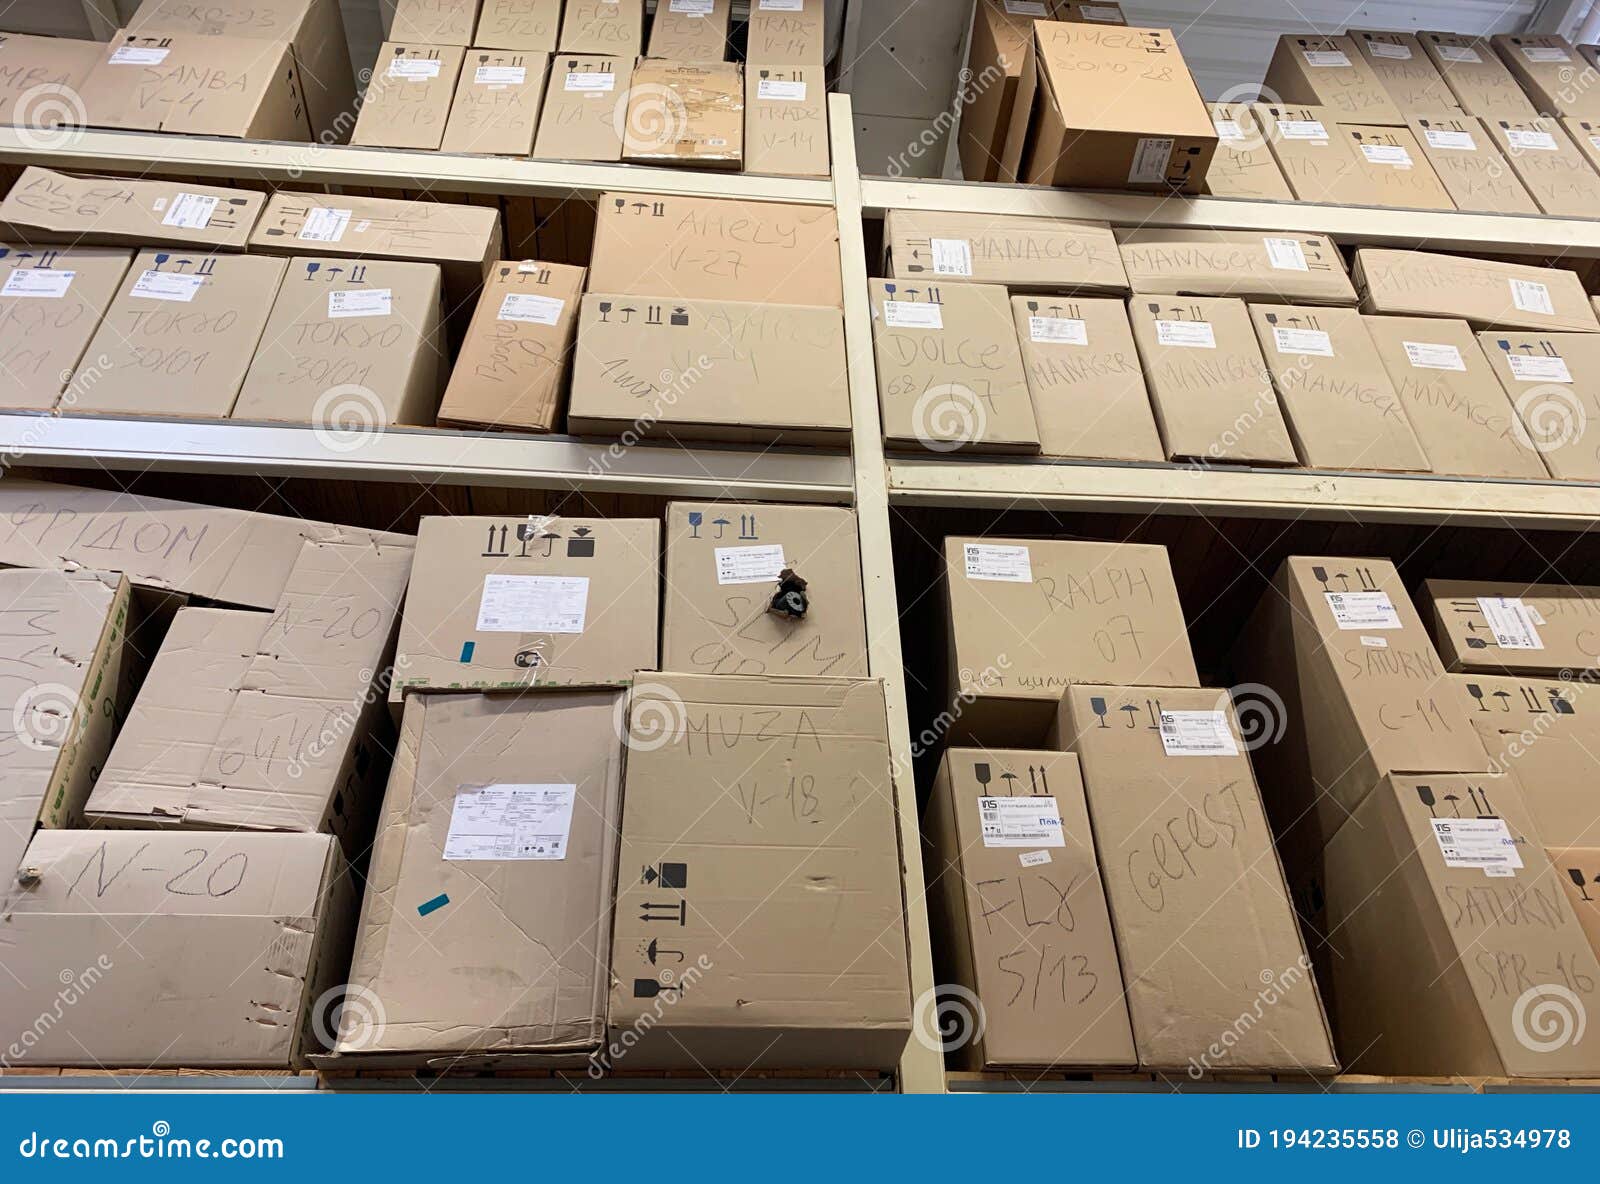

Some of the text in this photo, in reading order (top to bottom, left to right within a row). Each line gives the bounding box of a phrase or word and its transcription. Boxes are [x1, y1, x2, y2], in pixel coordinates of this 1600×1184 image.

[0, 64, 72, 93] MBA
[142, 65, 248, 93] SAMBA
[667, 246, 746, 281] V-27
[1035, 565, 1154, 612] RALPH
[1343, 646, 1440, 681] SATURN
[685, 708, 823, 757] MUZA
[736, 773, 821, 824] V-18
[66, 840, 249, 899] N-20
[1444, 881, 1568, 931] SATURN
[997, 944, 1099, 1013] 5/13
